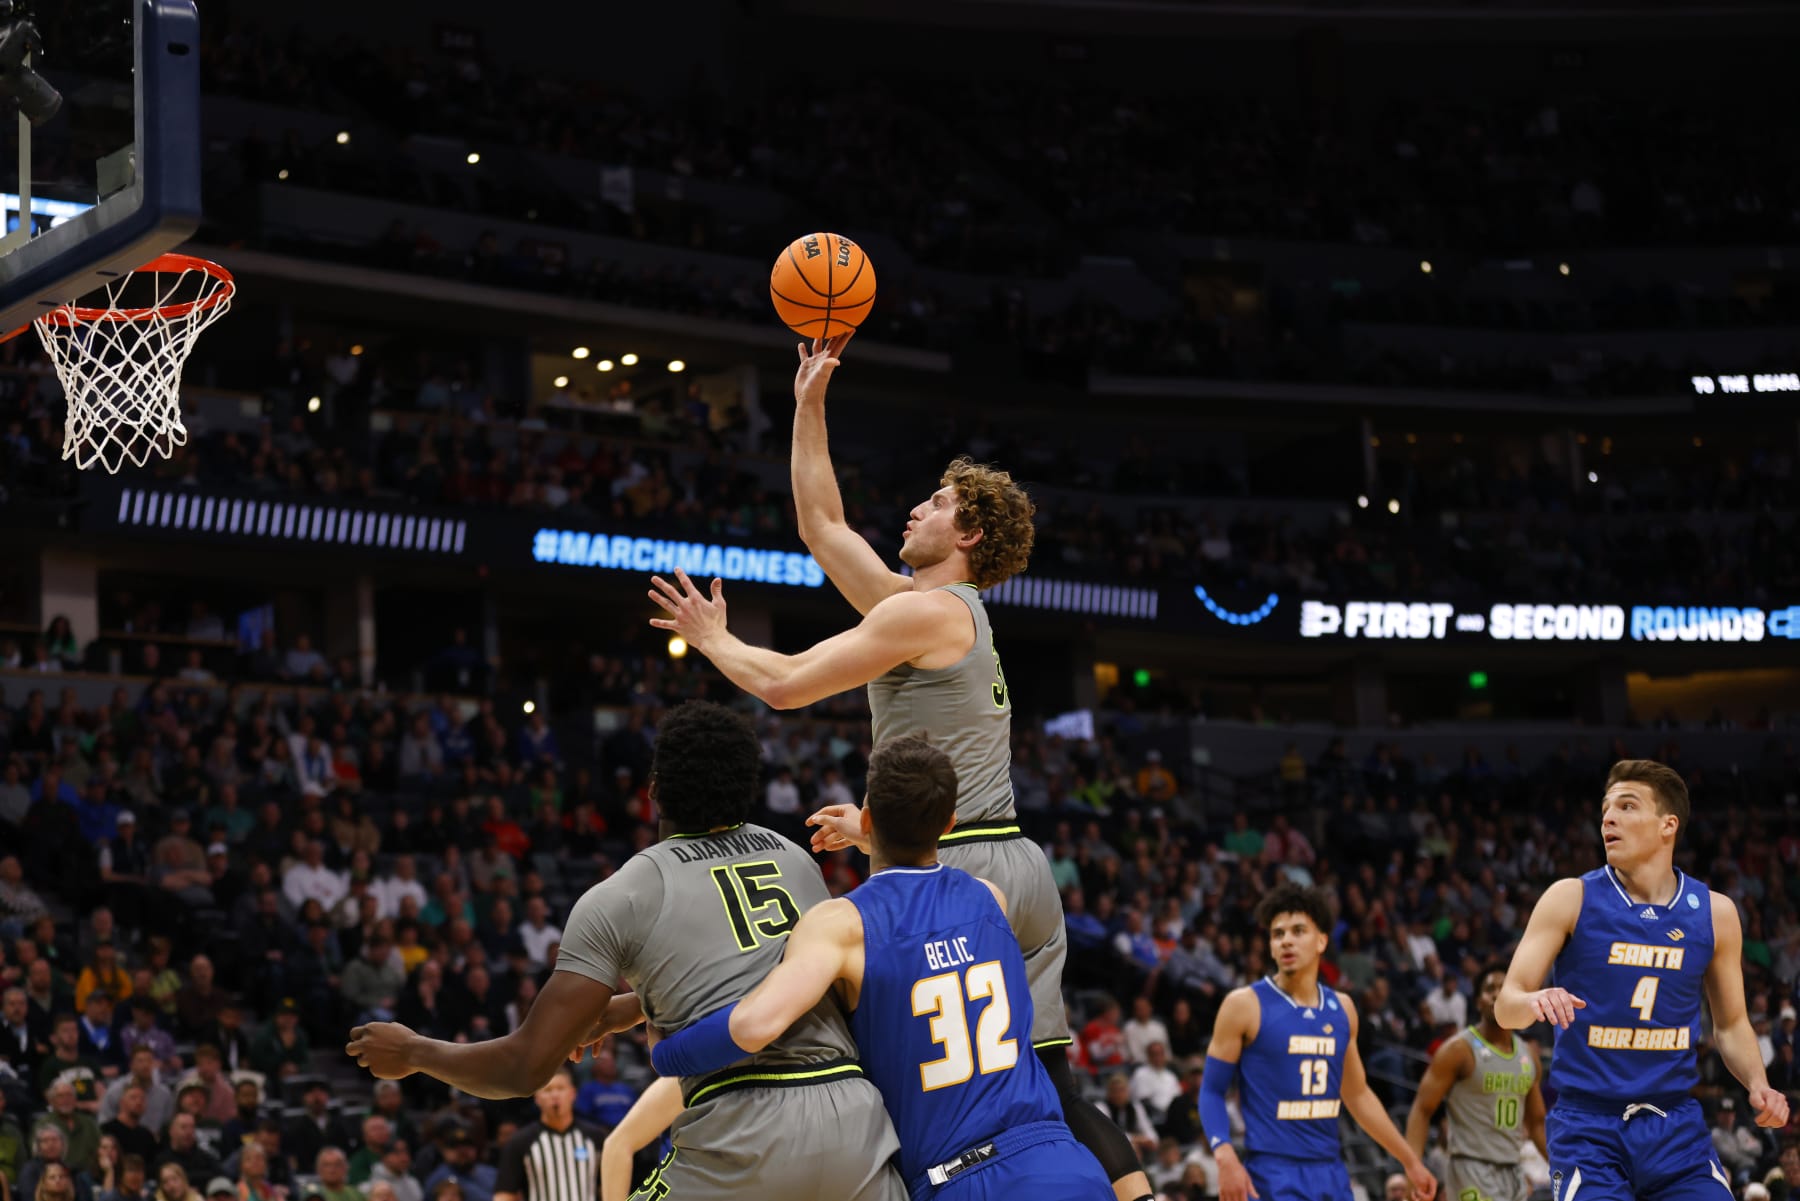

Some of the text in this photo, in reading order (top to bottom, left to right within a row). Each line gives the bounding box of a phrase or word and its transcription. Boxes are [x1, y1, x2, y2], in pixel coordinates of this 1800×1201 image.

[1718, 375, 1750, 393] THE
[533, 528, 825, 588] #MARCHMADNESS
[1344, 601, 1454, 640] FIRST
[1489, 603, 1625, 640] SECOND
[1630, 605, 1765, 642] ROUNDS
[710, 860, 801, 952] 15
[924, 936, 974, 970] BELIC
[1608, 941, 1684, 970] SANTA
[1630, 976, 1660, 1021] 4
[910, 960, 1019, 1093] 32
[1587, 1025, 1690, 1050] BARBARA
[1287, 1035, 1336, 1056] SANTA
[1299, 1059, 1328, 1096] 13
[1495, 1096, 1519, 1130] 10
